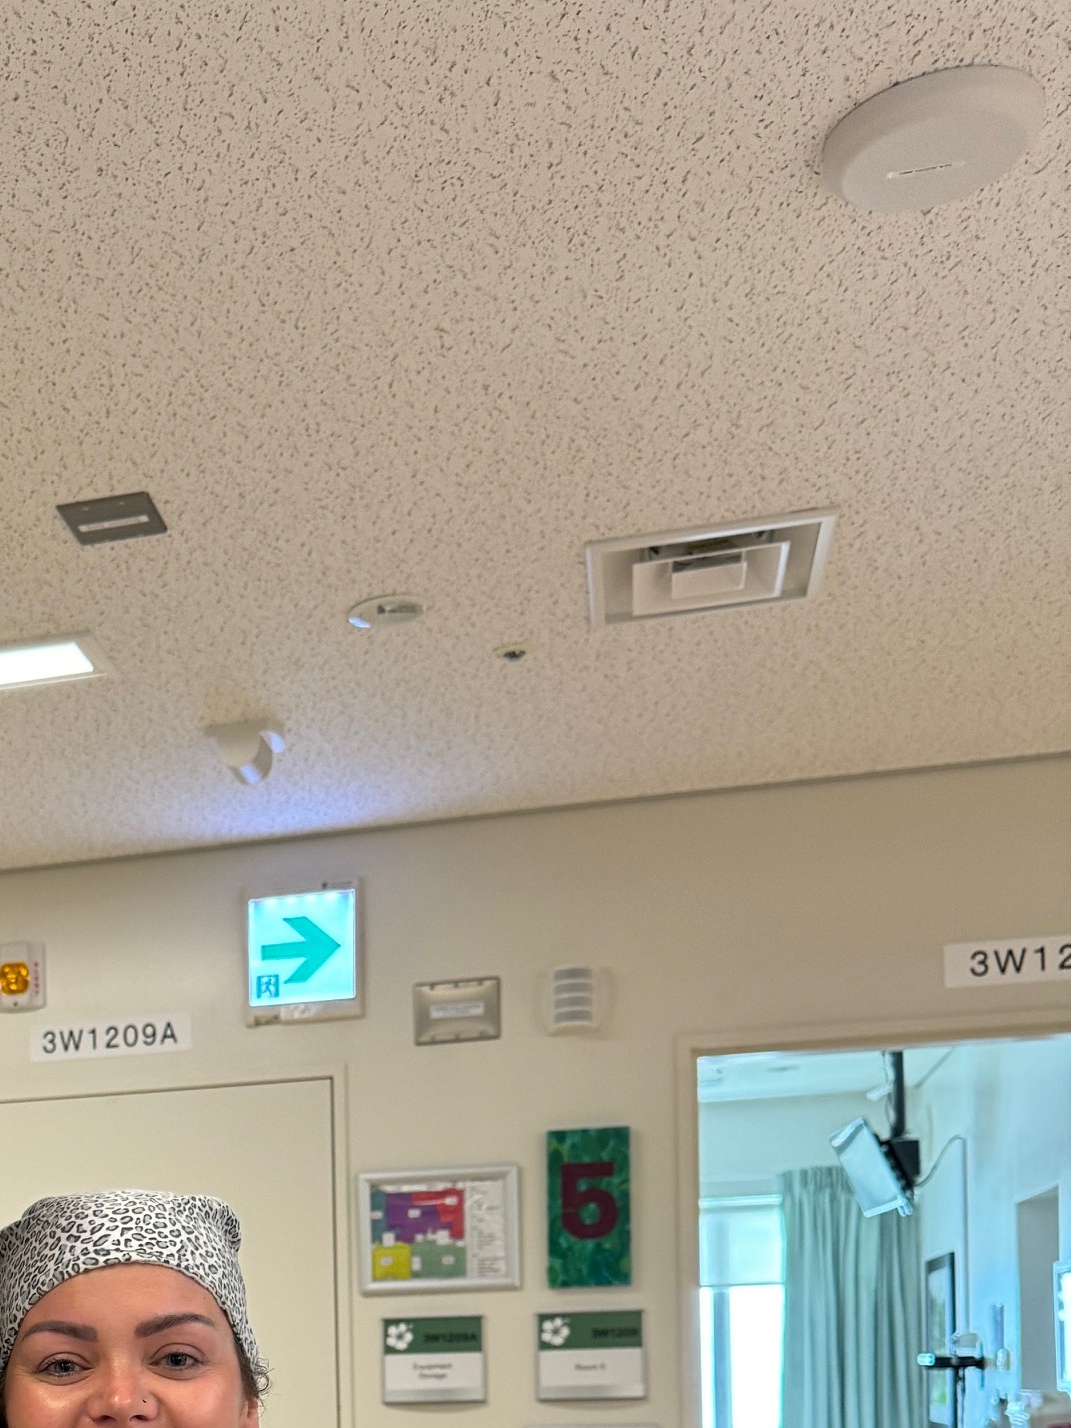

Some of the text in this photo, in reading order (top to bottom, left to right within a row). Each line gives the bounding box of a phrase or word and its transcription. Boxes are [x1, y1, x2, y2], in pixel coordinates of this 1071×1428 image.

[970, 943, 1071, 977] 3W12
[42, 1021, 178, 1054] 3W1209A
[561, 1162, 619, 1240] 5
